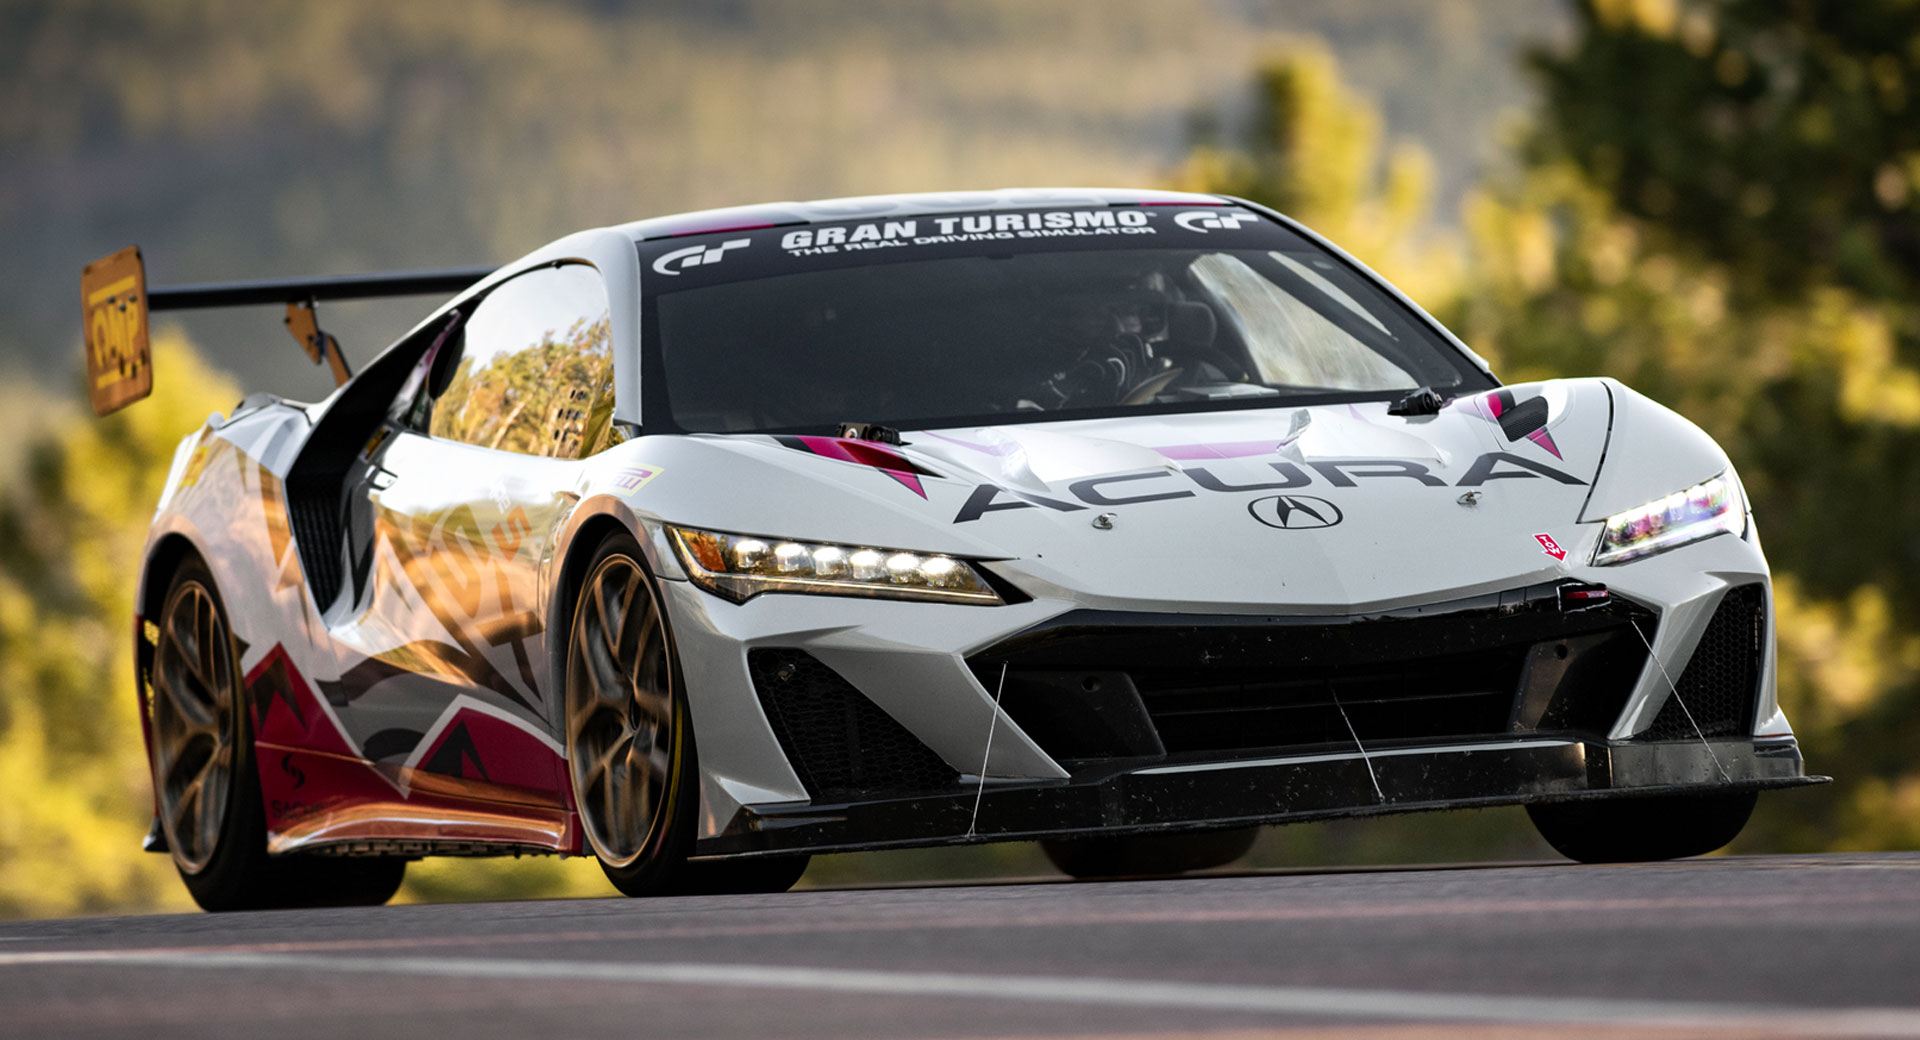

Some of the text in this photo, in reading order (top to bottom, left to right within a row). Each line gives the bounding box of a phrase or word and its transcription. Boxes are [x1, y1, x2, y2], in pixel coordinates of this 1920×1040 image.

[781, 210, 1148, 249] GRAN TURISMO
[788, 226, 1157, 257] THE REAL DRIVING SIMULATOR
[953, 451, 1590, 524] ACURA
[1539, 536, 1561, 554] TOW
